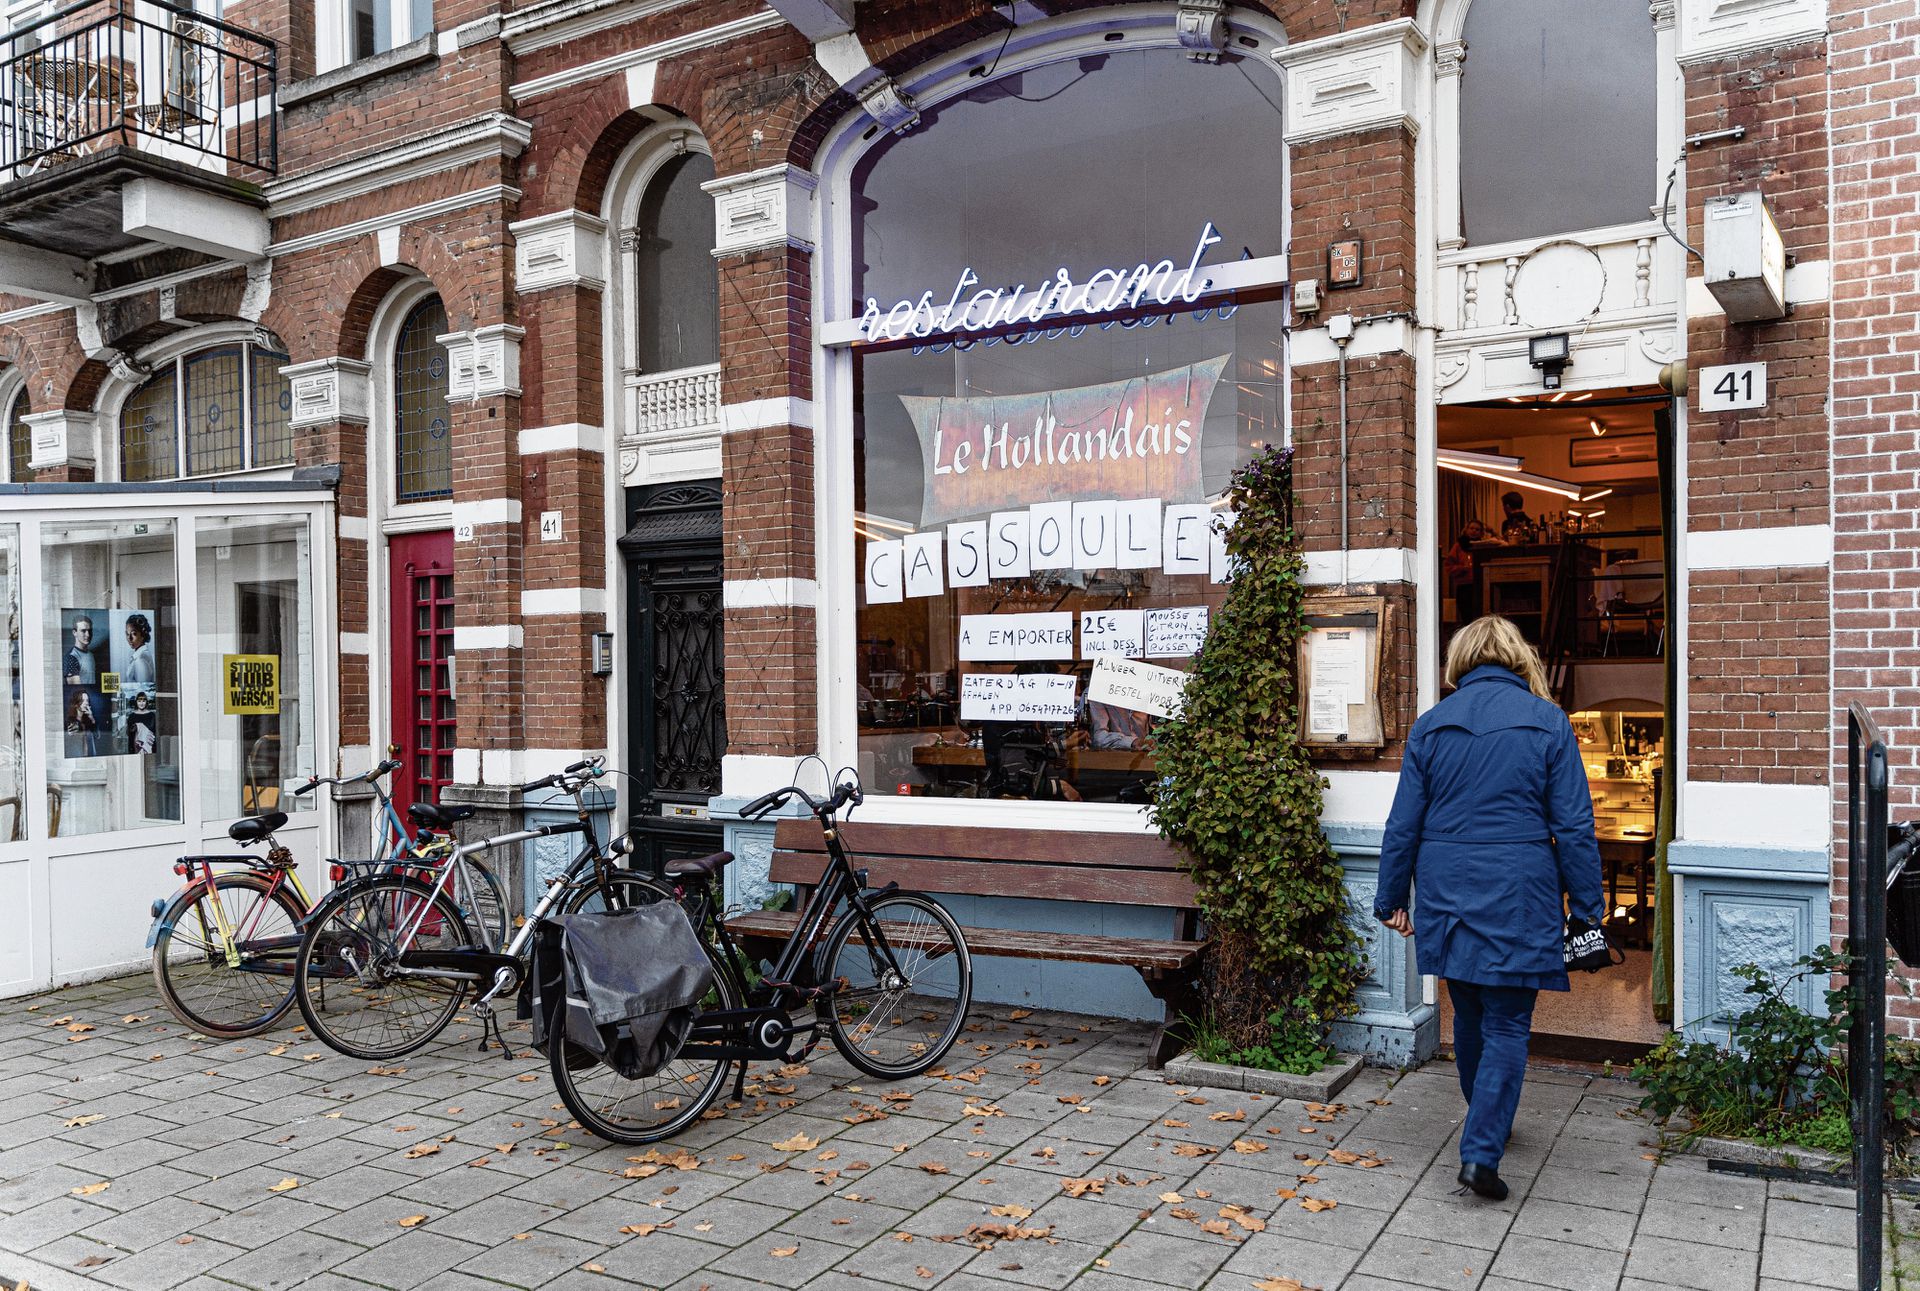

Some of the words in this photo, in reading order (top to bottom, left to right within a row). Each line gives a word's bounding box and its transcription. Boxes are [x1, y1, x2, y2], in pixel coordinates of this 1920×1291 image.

[859, 221, 1222, 342] restaurant
[1713, 370, 1752, 402] 41
[934, 429, 971, 475] Le
[981, 406, 1192, 471] Hollandais
[458, 526, 470, 537] 42
[543, 519, 557, 534] 41
[870, 513, 1200, 587] CASSOULE
[1083, 616, 1117, 634] 25€
[1149, 611, 1189, 622] MOUSSE
[988, 629, 1073, 646] EMPORTER
[230, 661, 273, 673] STUDIO
[1096, 657, 1137, 676] ALWEER
[230, 671, 274, 687] HUIB
[231, 690, 275, 706] WERSCH
[962, 690, 1000, 701] AFHALEN
[1108, 683, 1142, 700] BESTEL
